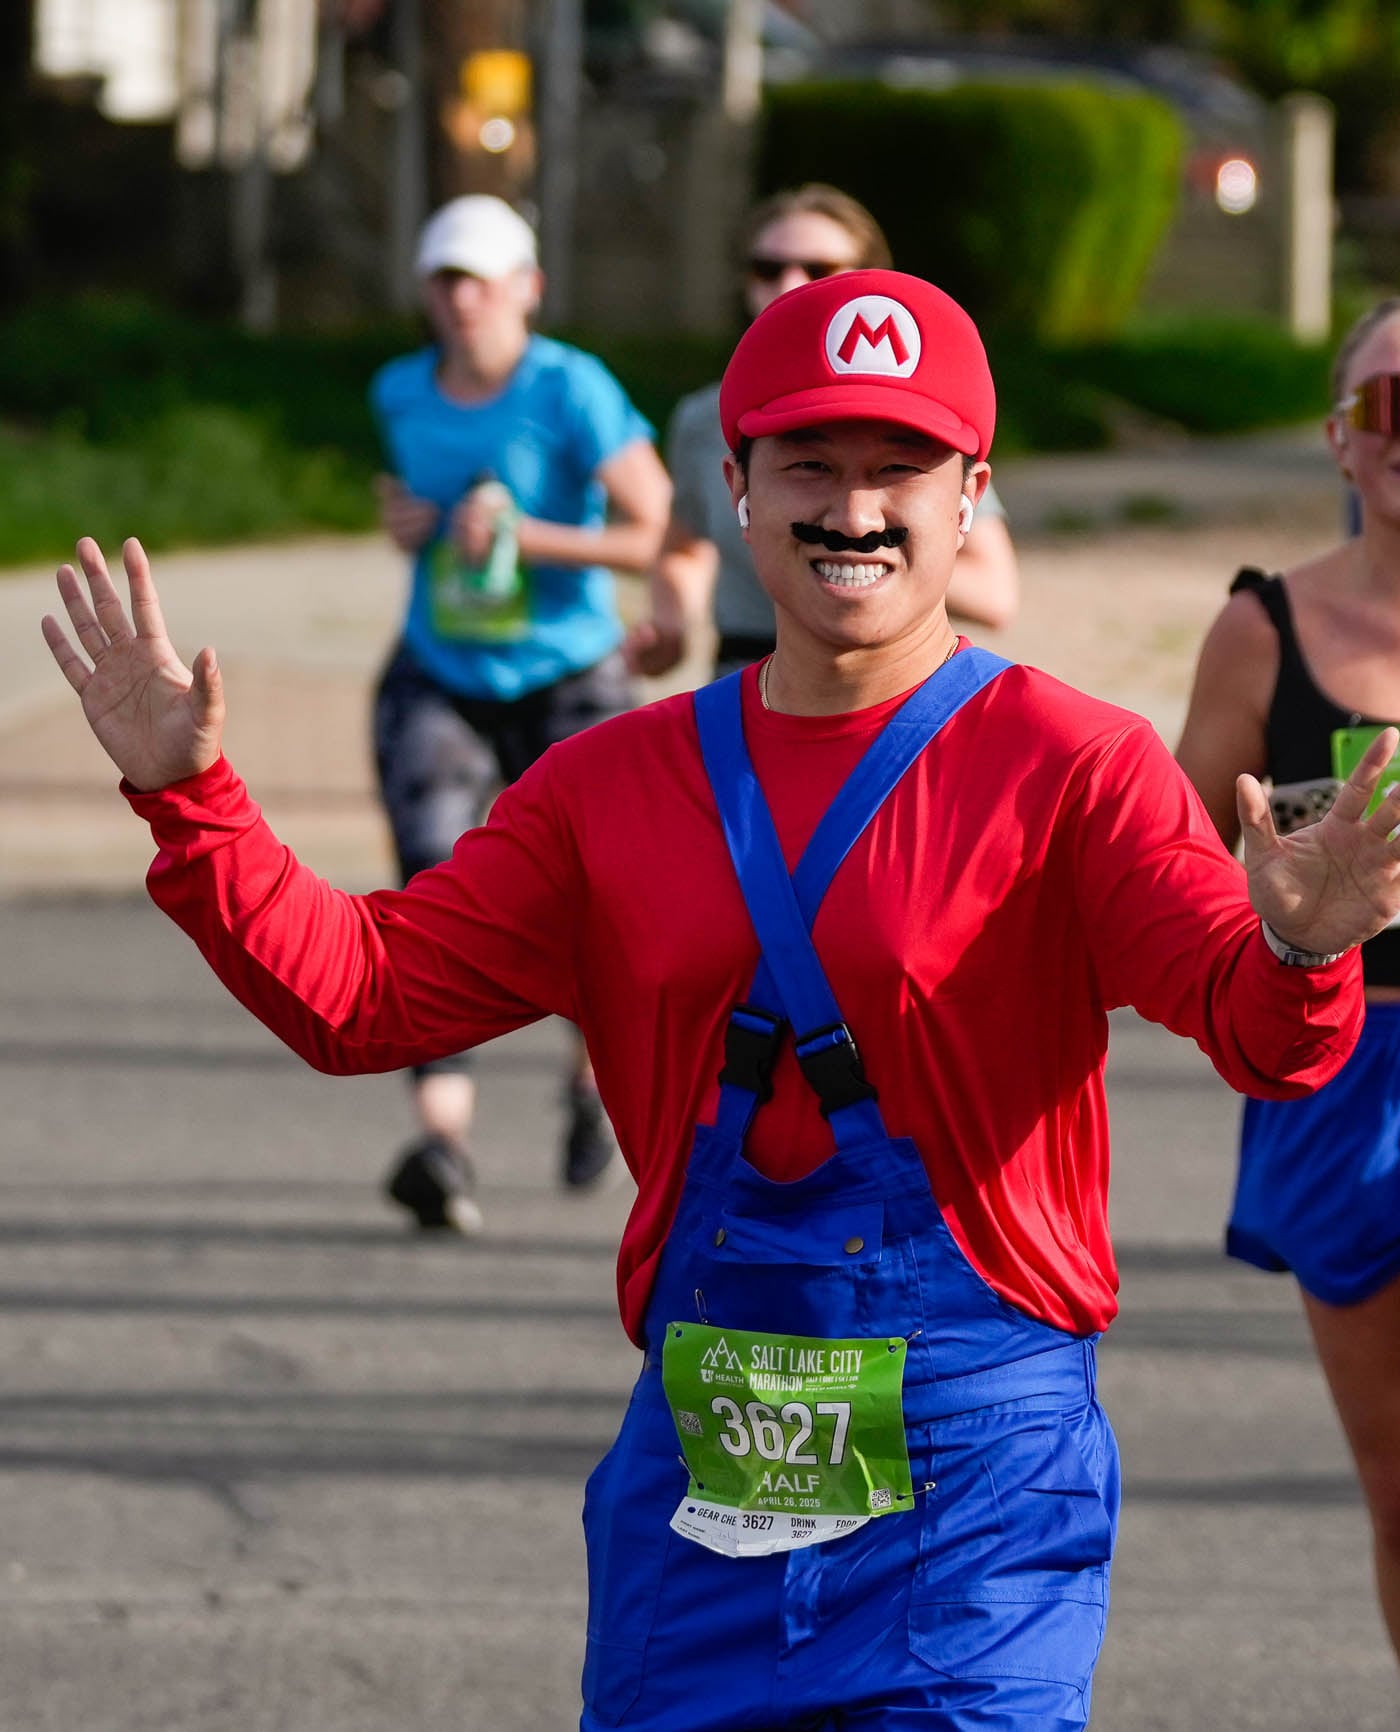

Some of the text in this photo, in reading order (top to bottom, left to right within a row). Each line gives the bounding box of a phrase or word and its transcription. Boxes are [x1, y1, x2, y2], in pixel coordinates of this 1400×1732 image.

[837, 312, 910, 366] M
[751, 1344, 863, 1374] SALT LAKE CITY
[715, 1373, 744, 1384] HEALTH
[749, 1372, 803, 1392] MARATHON
[711, 1396, 851, 1465] 3627
[758, 1496, 782, 1506] APRIL
[799, 1498, 821, 1508] 2025
[697, 1507, 720, 1521] GEAR
[742, 1513, 774, 1531] 3627
[791, 1517, 816, 1529] DRINK
[791, 1530, 812, 1539] 3627
